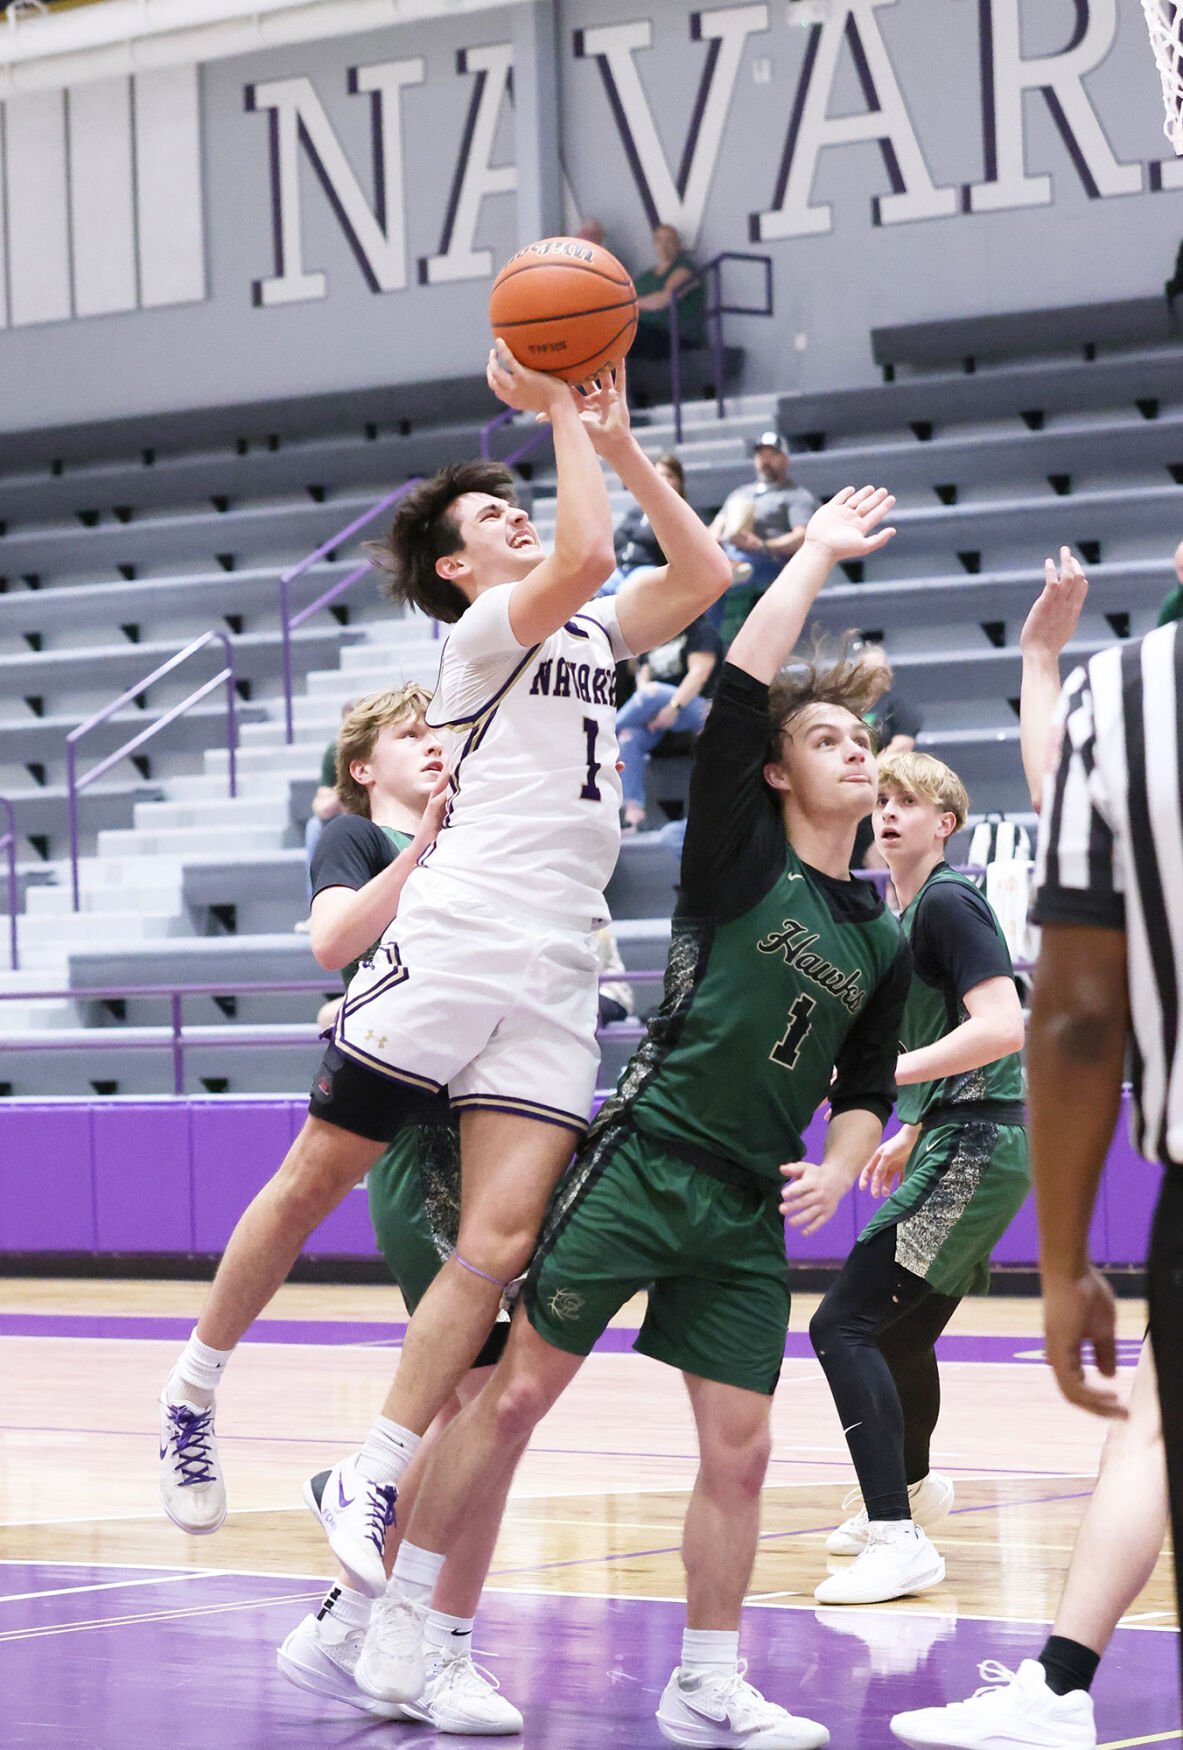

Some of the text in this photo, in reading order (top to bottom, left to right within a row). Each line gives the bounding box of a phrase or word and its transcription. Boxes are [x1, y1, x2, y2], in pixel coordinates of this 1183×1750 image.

[244, 0, 1183, 307] NAVAR
[579, 715, 602, 803] 1
[757, 918, 865, 1015] Hawks
[768, 992, 817, 1071] 1
